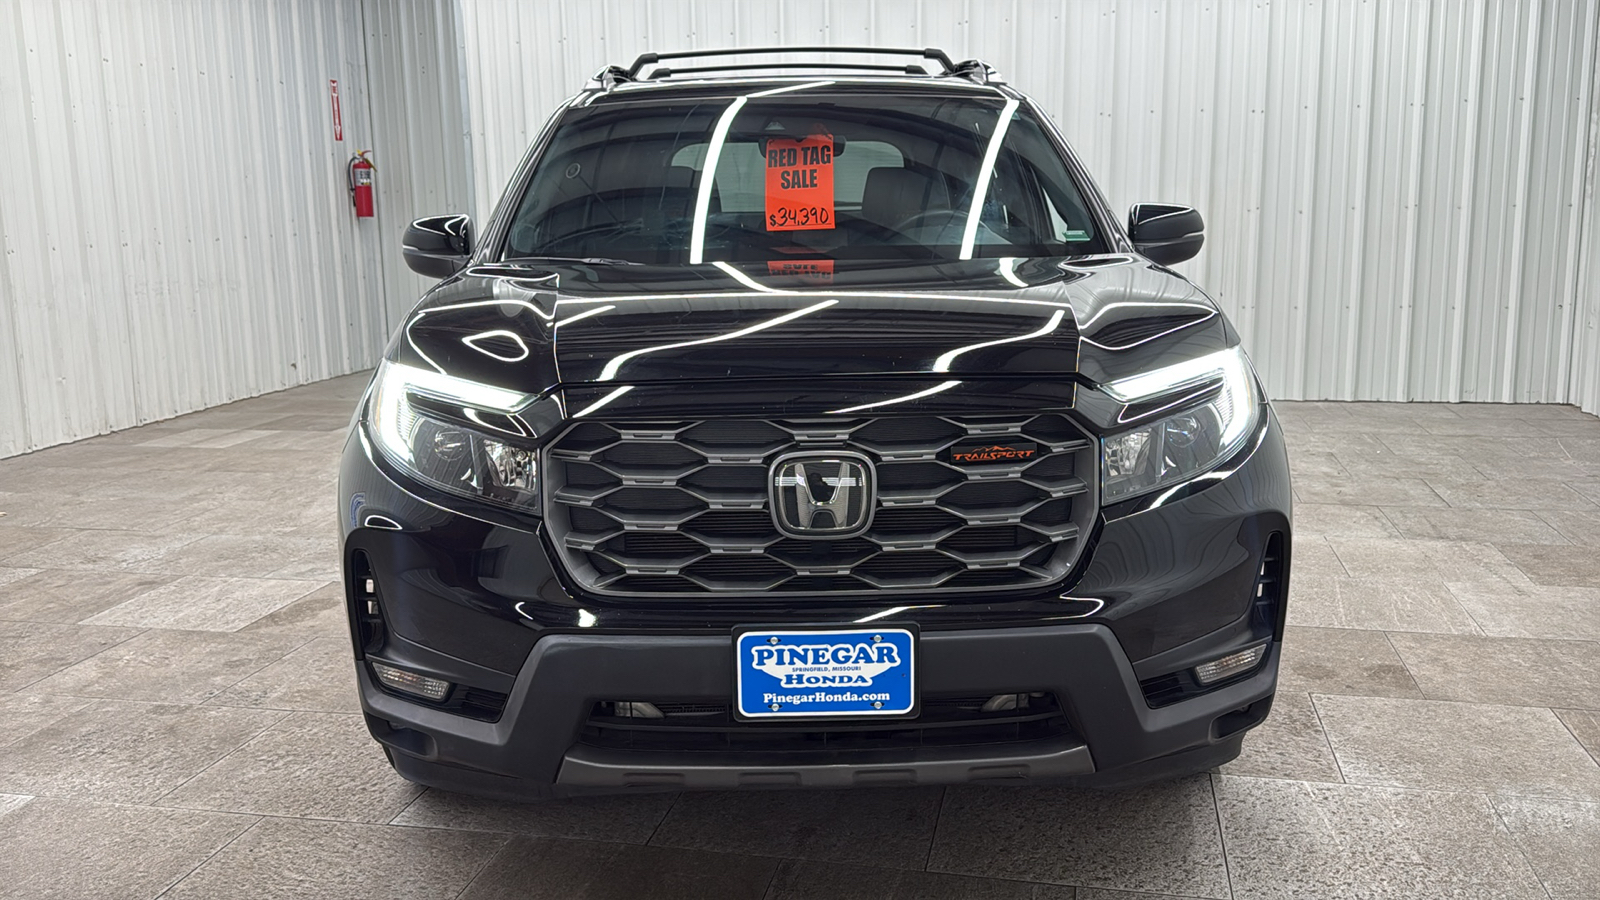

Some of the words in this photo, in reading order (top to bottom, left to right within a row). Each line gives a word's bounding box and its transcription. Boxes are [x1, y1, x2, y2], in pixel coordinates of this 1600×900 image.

[768, 148, 798, 168] RED
[801, 145, 831, 165] TAG
[780, 169, 818, 190] SALE
[953, 450, 1035, 462] TRAILSPORT
[755, 646, 899, 666] PINEGAR
[763, 692, 890, 705] PinegarHonda.com
